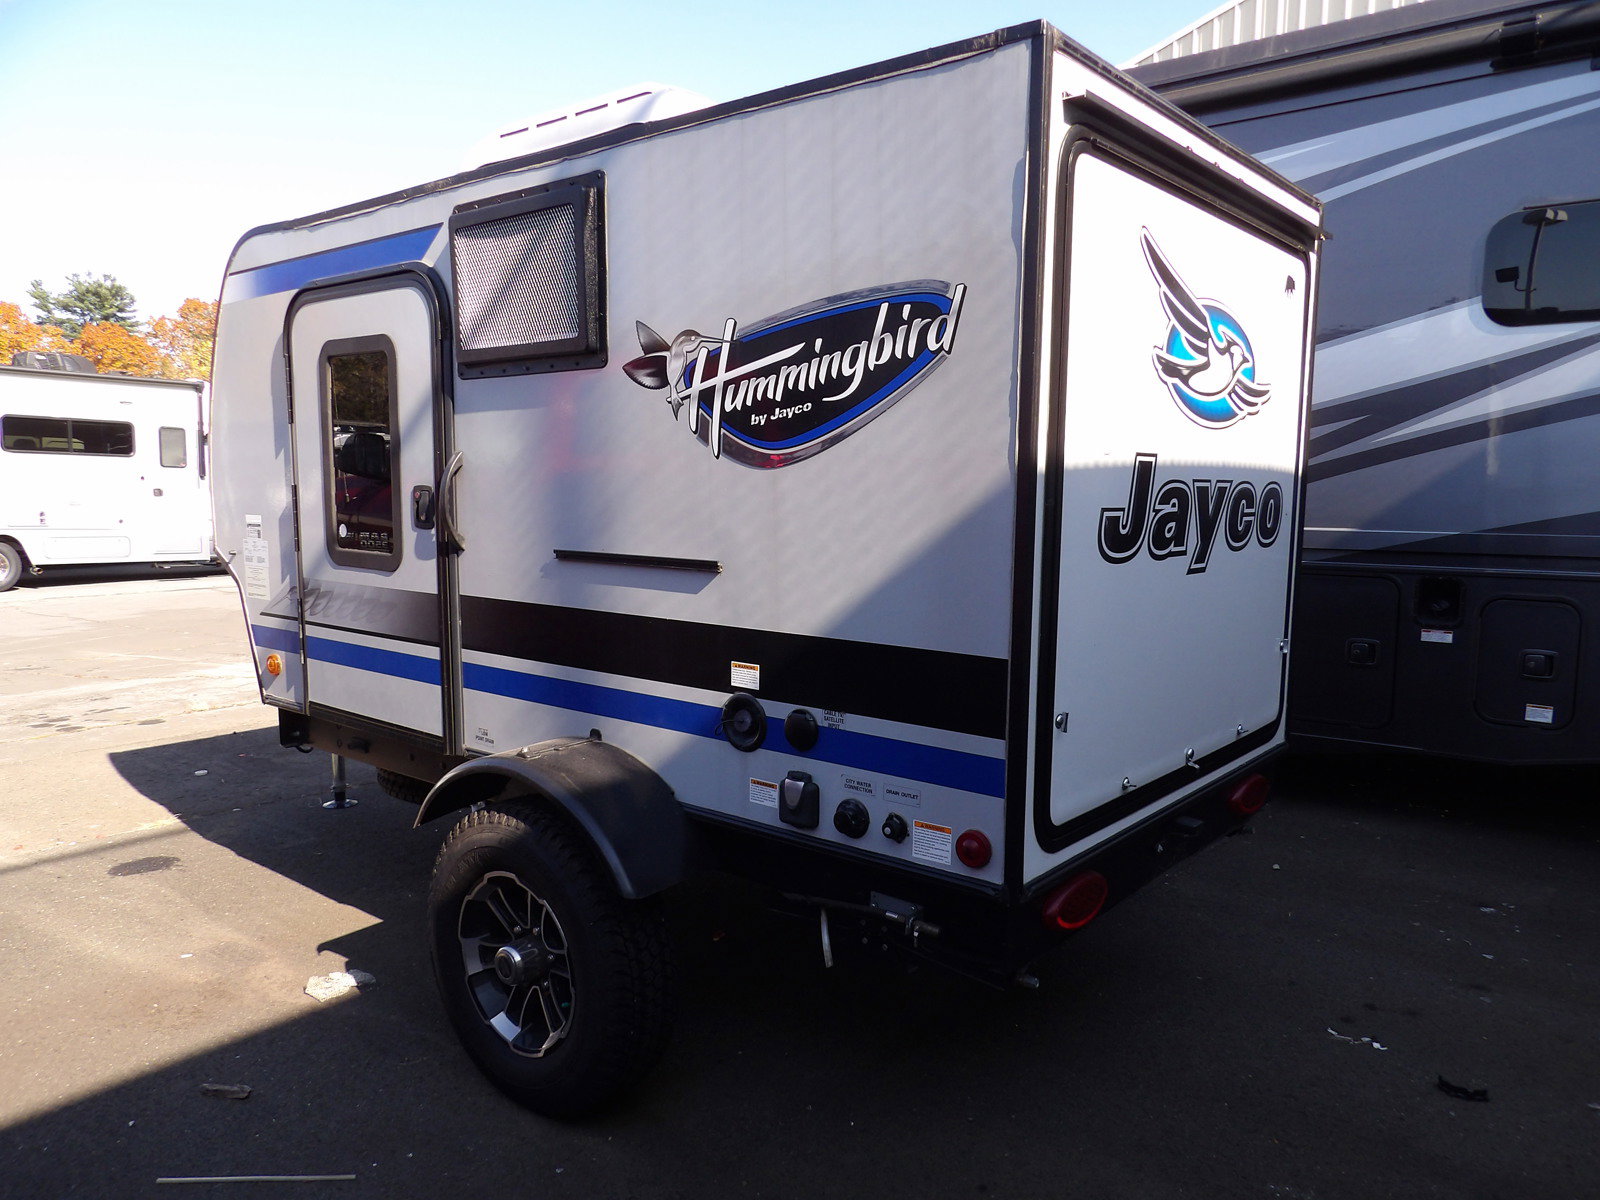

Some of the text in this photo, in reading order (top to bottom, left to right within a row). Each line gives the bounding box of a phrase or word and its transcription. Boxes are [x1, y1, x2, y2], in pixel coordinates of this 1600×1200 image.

[667, 283, 967, 459] Hummingbird
[750, 402, 813, 426] by Jayco
[1097, 452, 1283, 575] Jayco
[824, 716, 844, 724] SATELLITE
[844, 783, 873, 794] CONNECTION
[856, 780, 872, 788] WATER
[885, 788, 919, 800] DRAIN OUTLET
